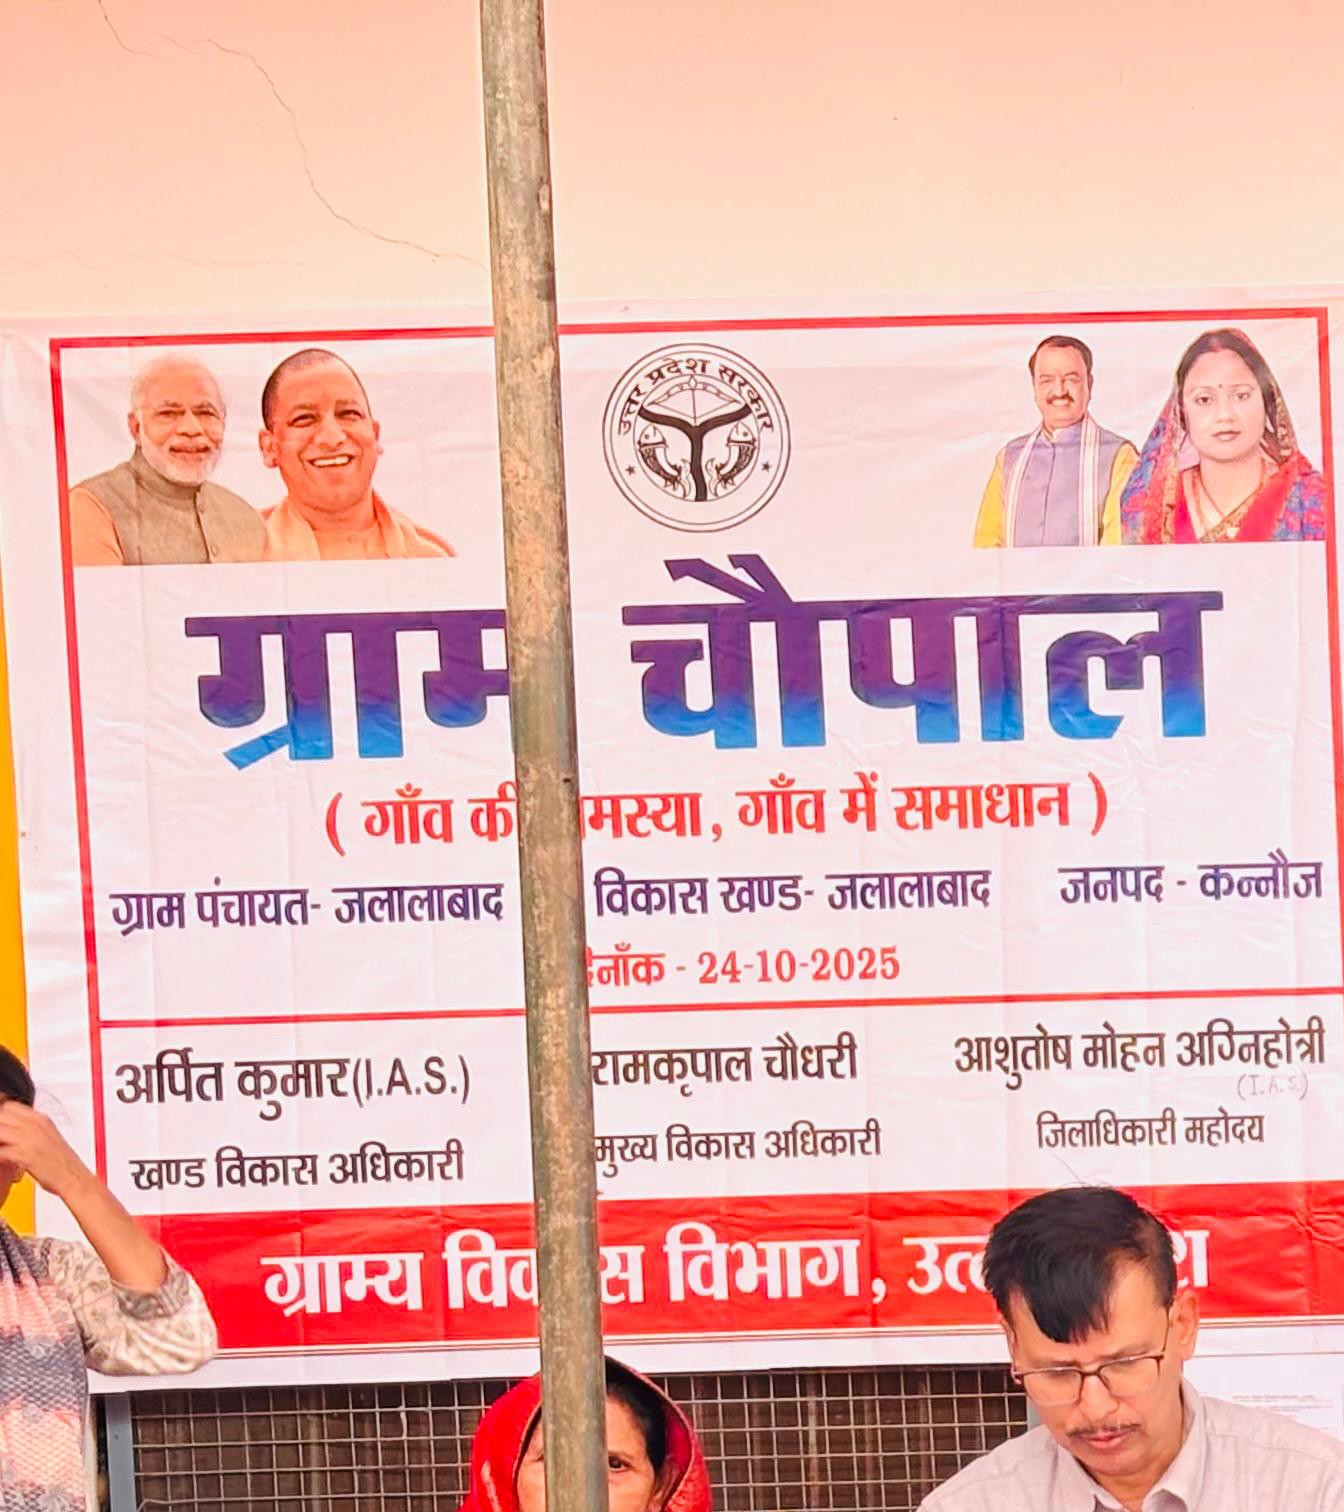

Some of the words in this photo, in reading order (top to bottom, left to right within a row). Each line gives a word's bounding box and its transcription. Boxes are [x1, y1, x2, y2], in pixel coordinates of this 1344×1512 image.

[645, 358, 711, 385] प्रदेश
[718, 363, 774, 434] सरकार
[184, 609, 514, 770] ग्राम
[622, 553, 1224, 751] चौपाल
[361, 783, 453, 845] गाँव
[580, 791, 723, 845] मस्या,
[735, 772, 826, 836] गाँव
[839, 771, 878, 832] में
[891, 780, 1070, 832] समाधान
[594, 866, 708, 917] विकास
[825, 867, 991, 912] जलालाबाद
[1058, 864, 1166, 905] जनपद
[1198, 848, 1324, 902] कन्नौज
[109, 888, 186, 937] ग्राम
[331, 881, 505, 928] जलालाबाद
[697, 946, 901, 986] 24-10-2025
[116, 1048, 225, 1107] अर्पित
[592, 1046, 753, 1098] रामकृपाल
[762, 1031, 858, 1085] चौधरी
[954, 1023, 1073, 1090] आशुतोष
[1082, 1020, 1166, 1072] मोहन
[1176, 1014, 1327, 1070] अग्निहोत्री
[594, 1133, 658, 1178] मुख्य
[665, 1124, 756, 1162] विकास
[764, 1119, 882, 1160] अधिकारी
[1036, 1107, 1177, 1150] जिलाधिकारी
[1183, 1107, 1265, 1148] महोदय
[129, 1153, 206, 1192] खण्ड
[215, 1145, 319, 1190] विकास
[328, 1139, 465, 1185] अधिकारी
[261, 1250, 424, 1319] ग्राम्य
